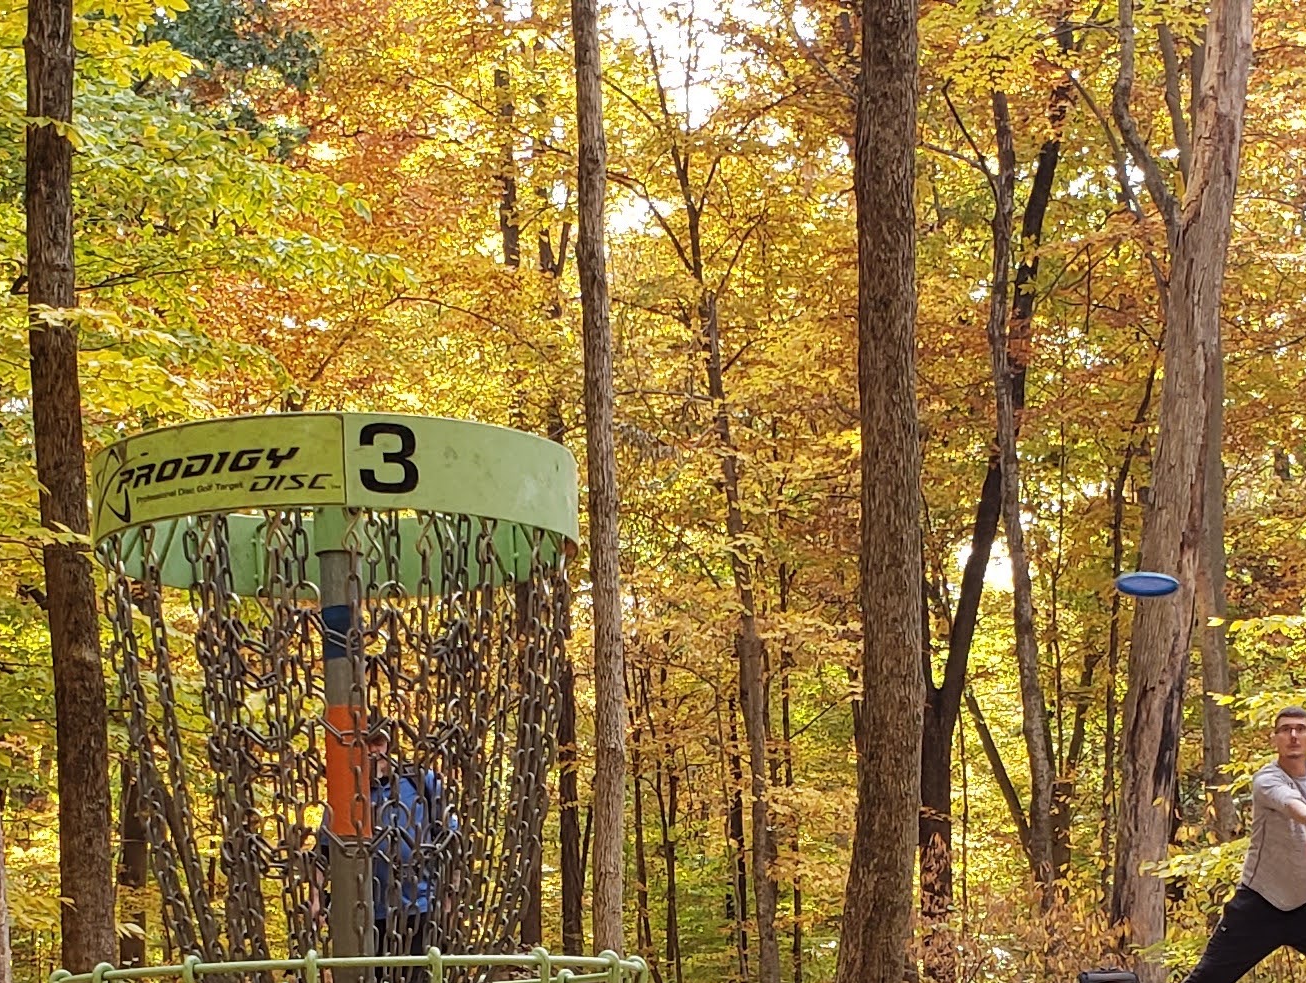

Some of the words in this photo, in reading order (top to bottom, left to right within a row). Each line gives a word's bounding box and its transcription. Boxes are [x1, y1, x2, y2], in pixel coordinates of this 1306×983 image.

[116, 446, 300, 494] PRODIGY
[359, 422, 420, 494] 3
[214, 481, 244, 492] Target
[249, 473, 333, 493] DISC
